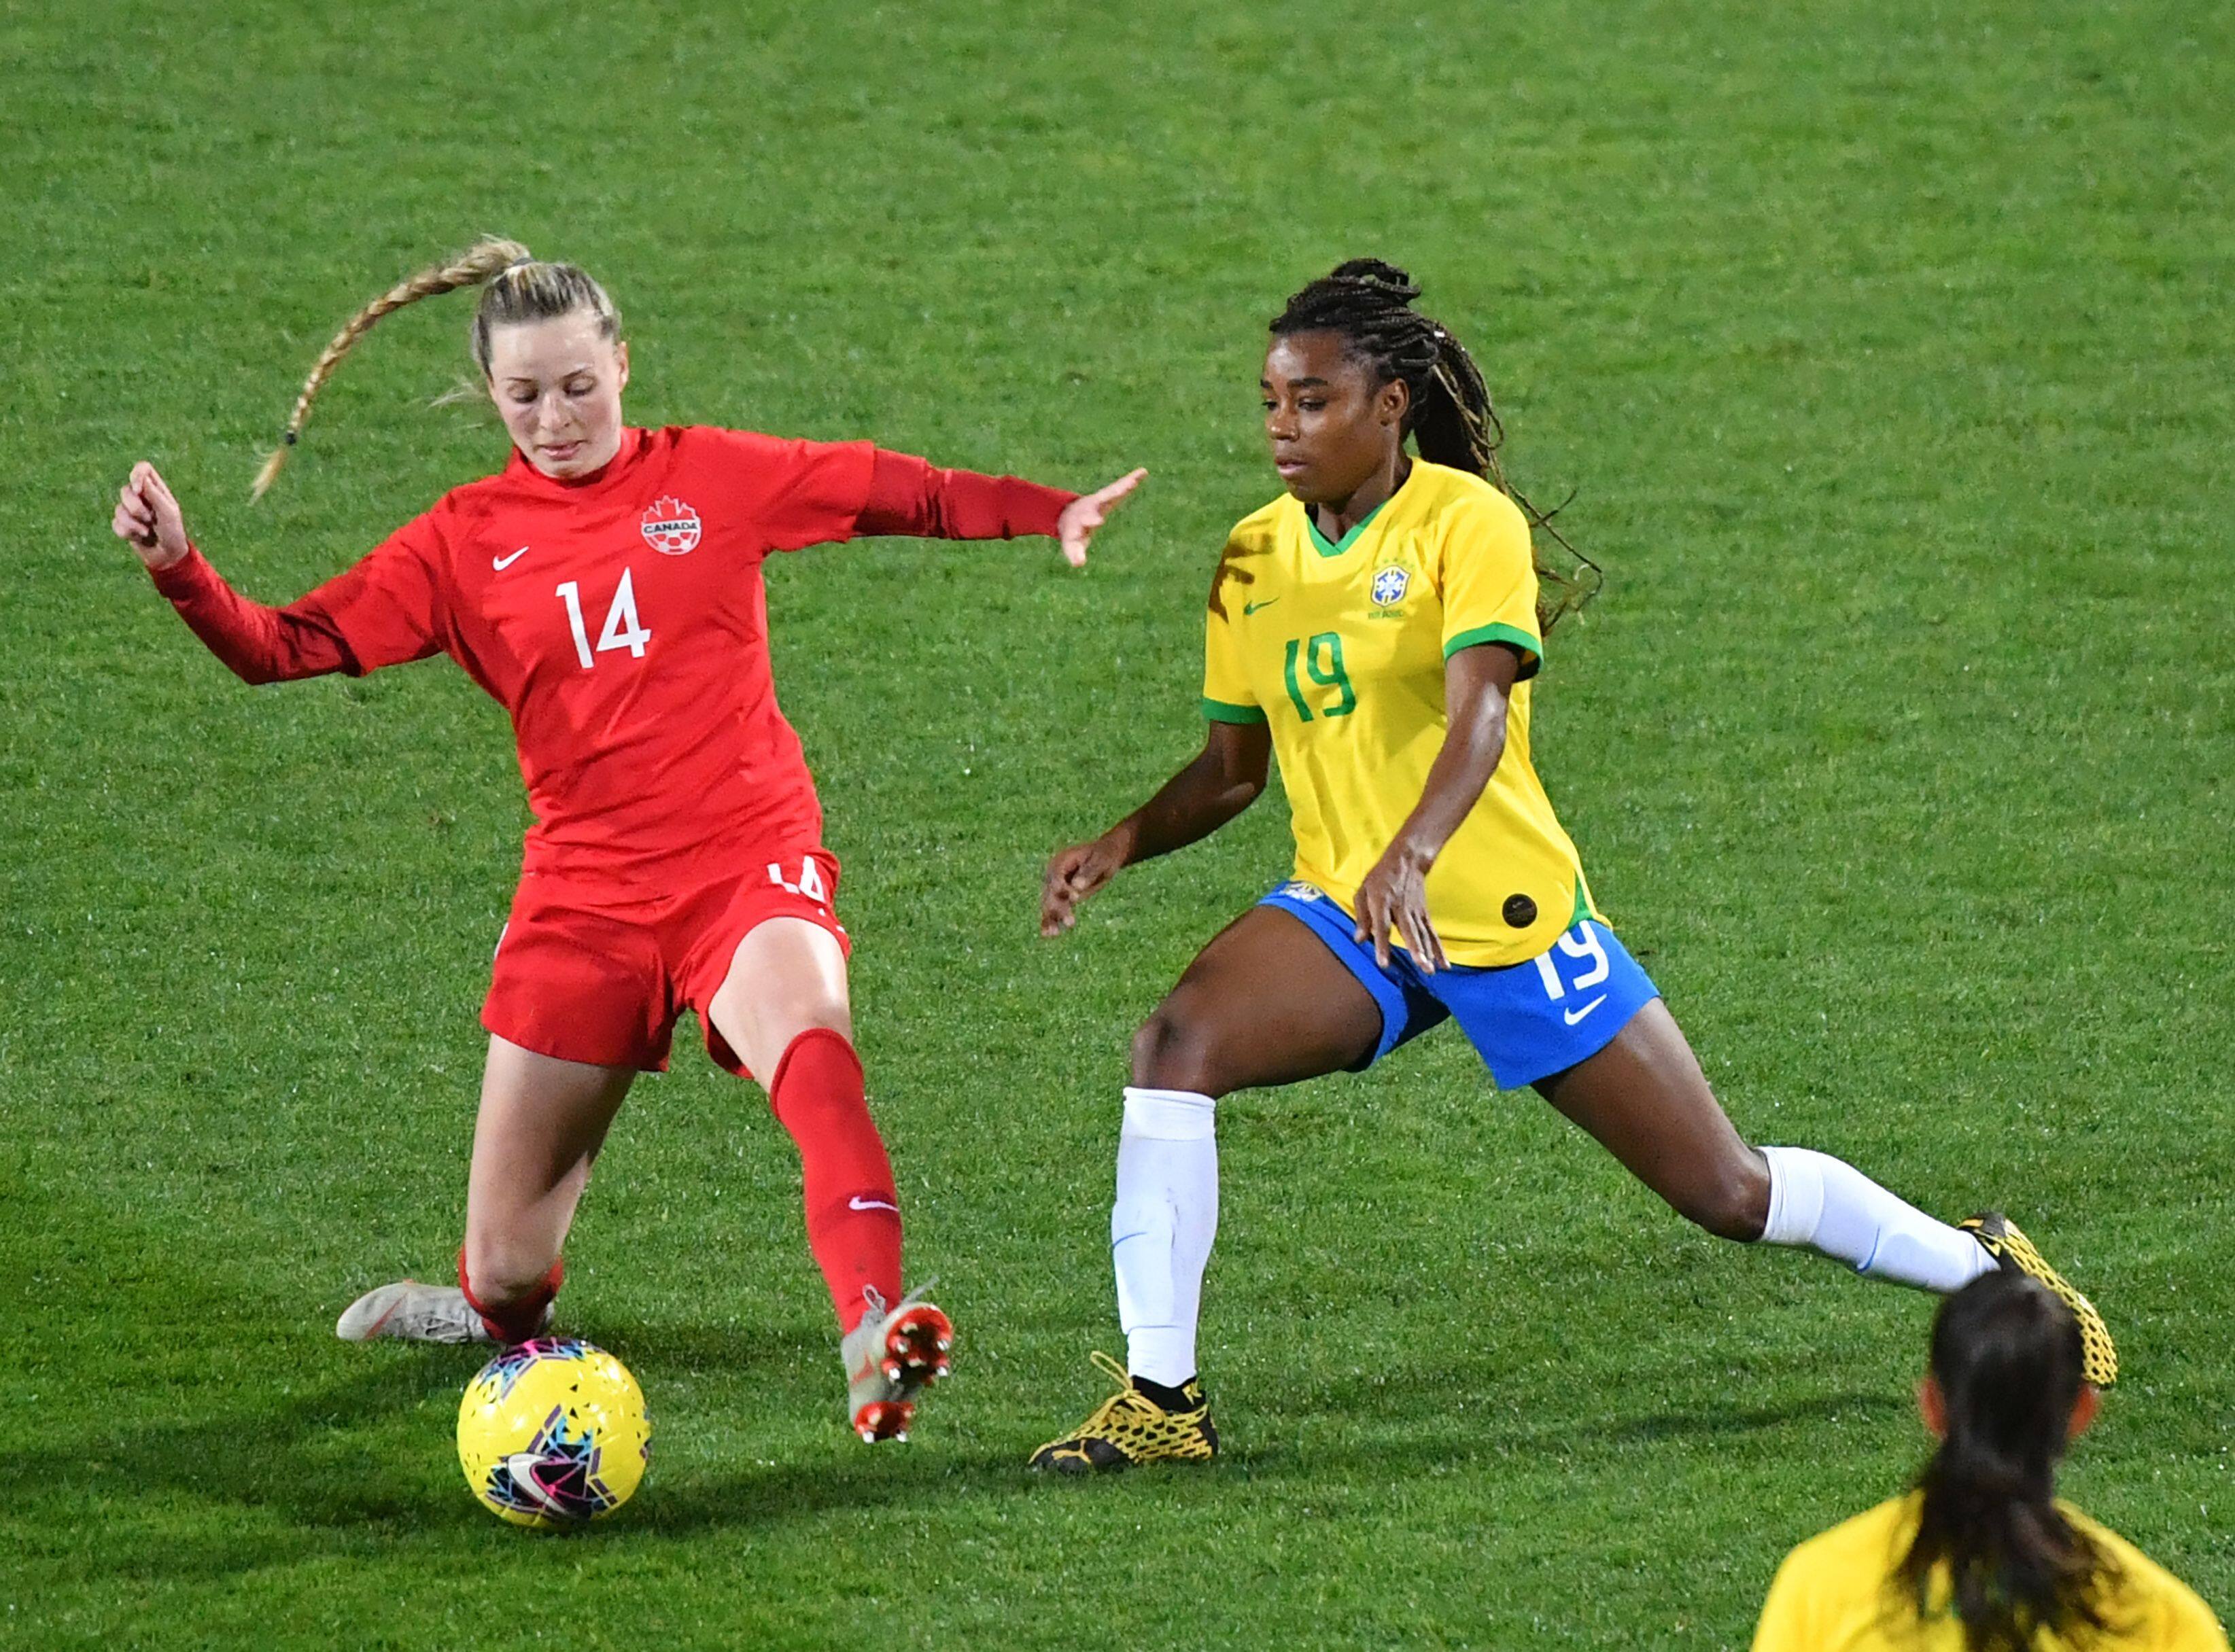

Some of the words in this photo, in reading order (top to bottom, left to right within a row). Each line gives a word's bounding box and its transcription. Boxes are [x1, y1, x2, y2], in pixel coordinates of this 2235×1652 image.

[644, 523, 697, 533] CANADA
[555, 567, 651, 668] 14
[1284, 632, 1356, 722] 19
[1534, 920, 1609, 1000] 19
